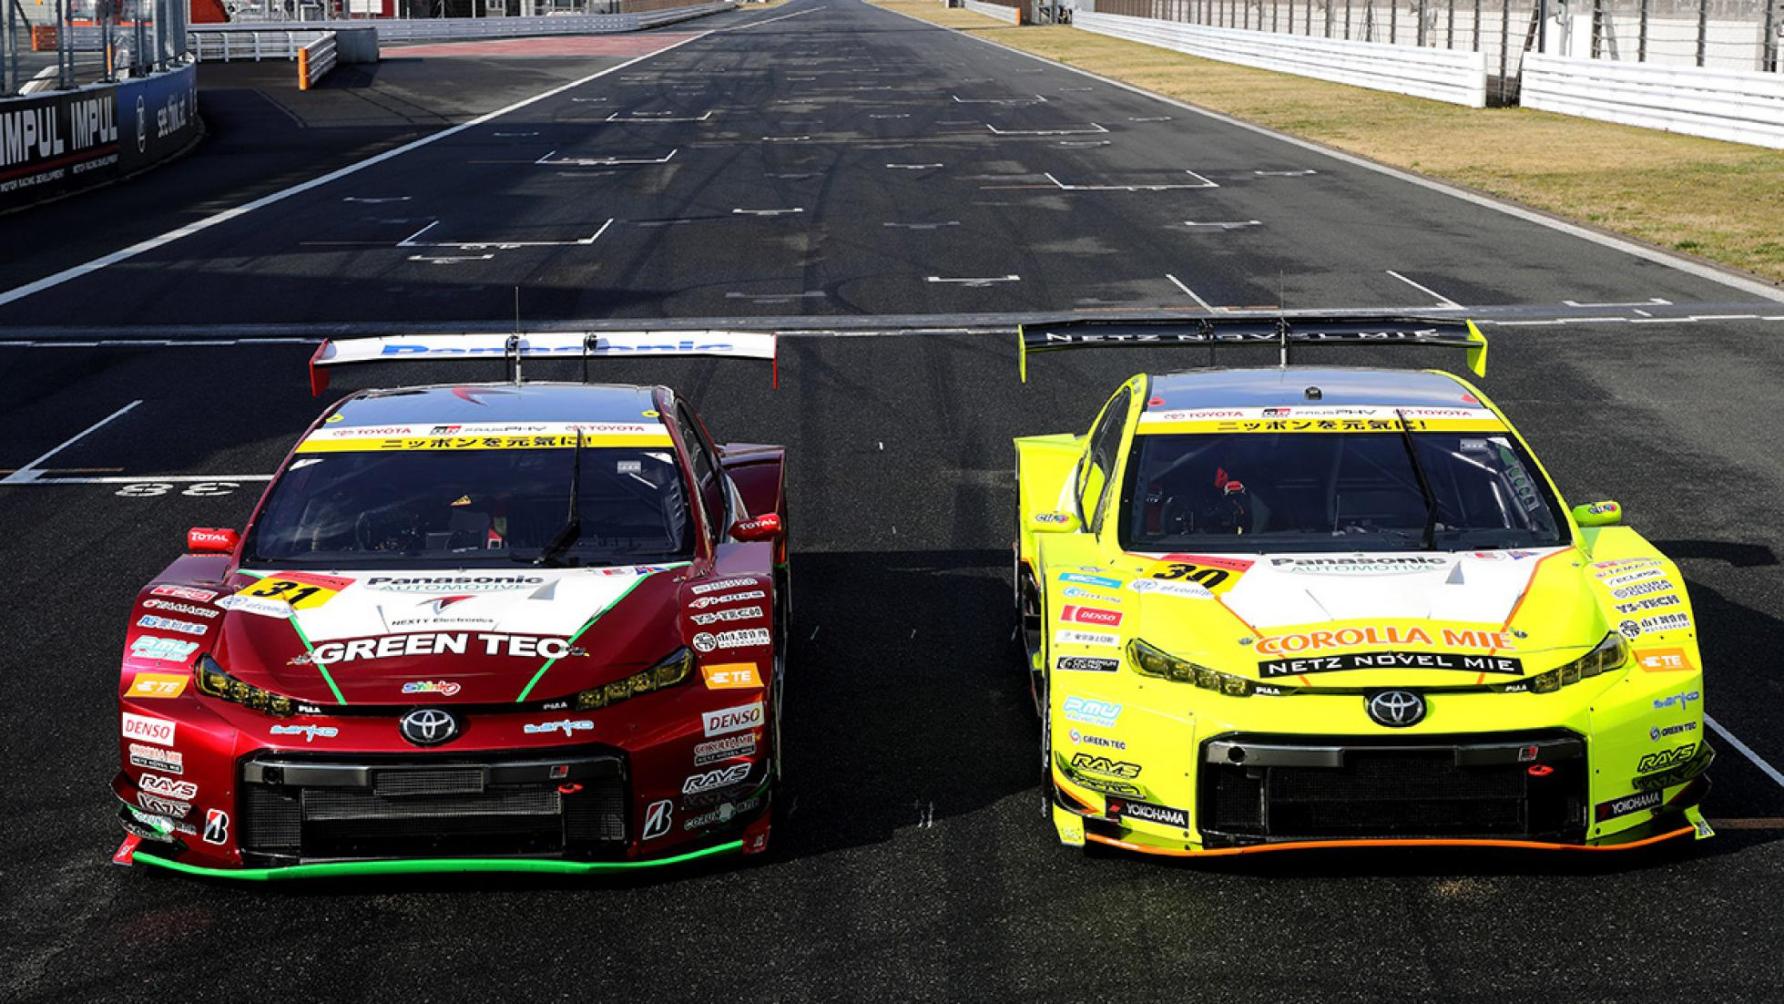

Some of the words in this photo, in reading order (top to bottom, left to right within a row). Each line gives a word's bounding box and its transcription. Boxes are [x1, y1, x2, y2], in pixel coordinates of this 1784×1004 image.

[71, 96, 118, 150] IMPUL
[0, 106, 64, 166] IMPUL
[1189, 410, 1244, 418] TOYOTA
[1416, 409, 1472, 417] TOYOTA
[356, 427, 412, 435] TOYOTA
[739, 519, 777, 531] TOTAL
[191, 531, 229, 542] TOTAL
[1270, 556, 1447, 567] Panasonic
[1291, 563, 1433, 572] AUTOMOTIVE
[367, 575, 544, 587] Panasonic
[1153, 563, 1230, 589] 30
[252, 581, 321, 606] 31
[379, 584, 527, 592] AUTOMOTIVE
[1616, 594, 1680, 614] YS-TECH
[433, 617, 495, 625] Electronics
[694, 607, 763, 626] YS-TECH
[1081, 611, 1117, 622] DENSO
[312, 632, 469, 664] GREEN
[478, 633, 573, 659] TEC
[1256, 627, 1432, 654] COROLLA
[1443, 628, 1517, 650] MIE
[1268, 657, 1343, 674] NETZ
[1354, 654, 1453, 667] NOVEL
[1464, 657, 1515, 671] MIE
[1662, 654, 1682, 666] TE
[732, 670, 752, 682] TE
[158, 681, 180, 692] TE
[1256, 686, 1280, 695] PIAA
[298, 705, 321, 714] PIAA
[543, 702, 568, 710] PIAA
[709, 708, 761, 731] DENSO
[125, 719, 171, 740] DENSO
[1083, 735, 1110, 748] GREEN
[1111, 739, 1126, 750] TEC
[1071, 752, 1142, 779] RAYS
[1638, 743, 1696, 773] RAYS
[684, 763, 751, 793] RAYS
[141, 775, 196, 797] RAYS
[1612, 792, 1660, 814] YOKOHAMA
[1127, 803, 1186, 825] YOKOHAMA
